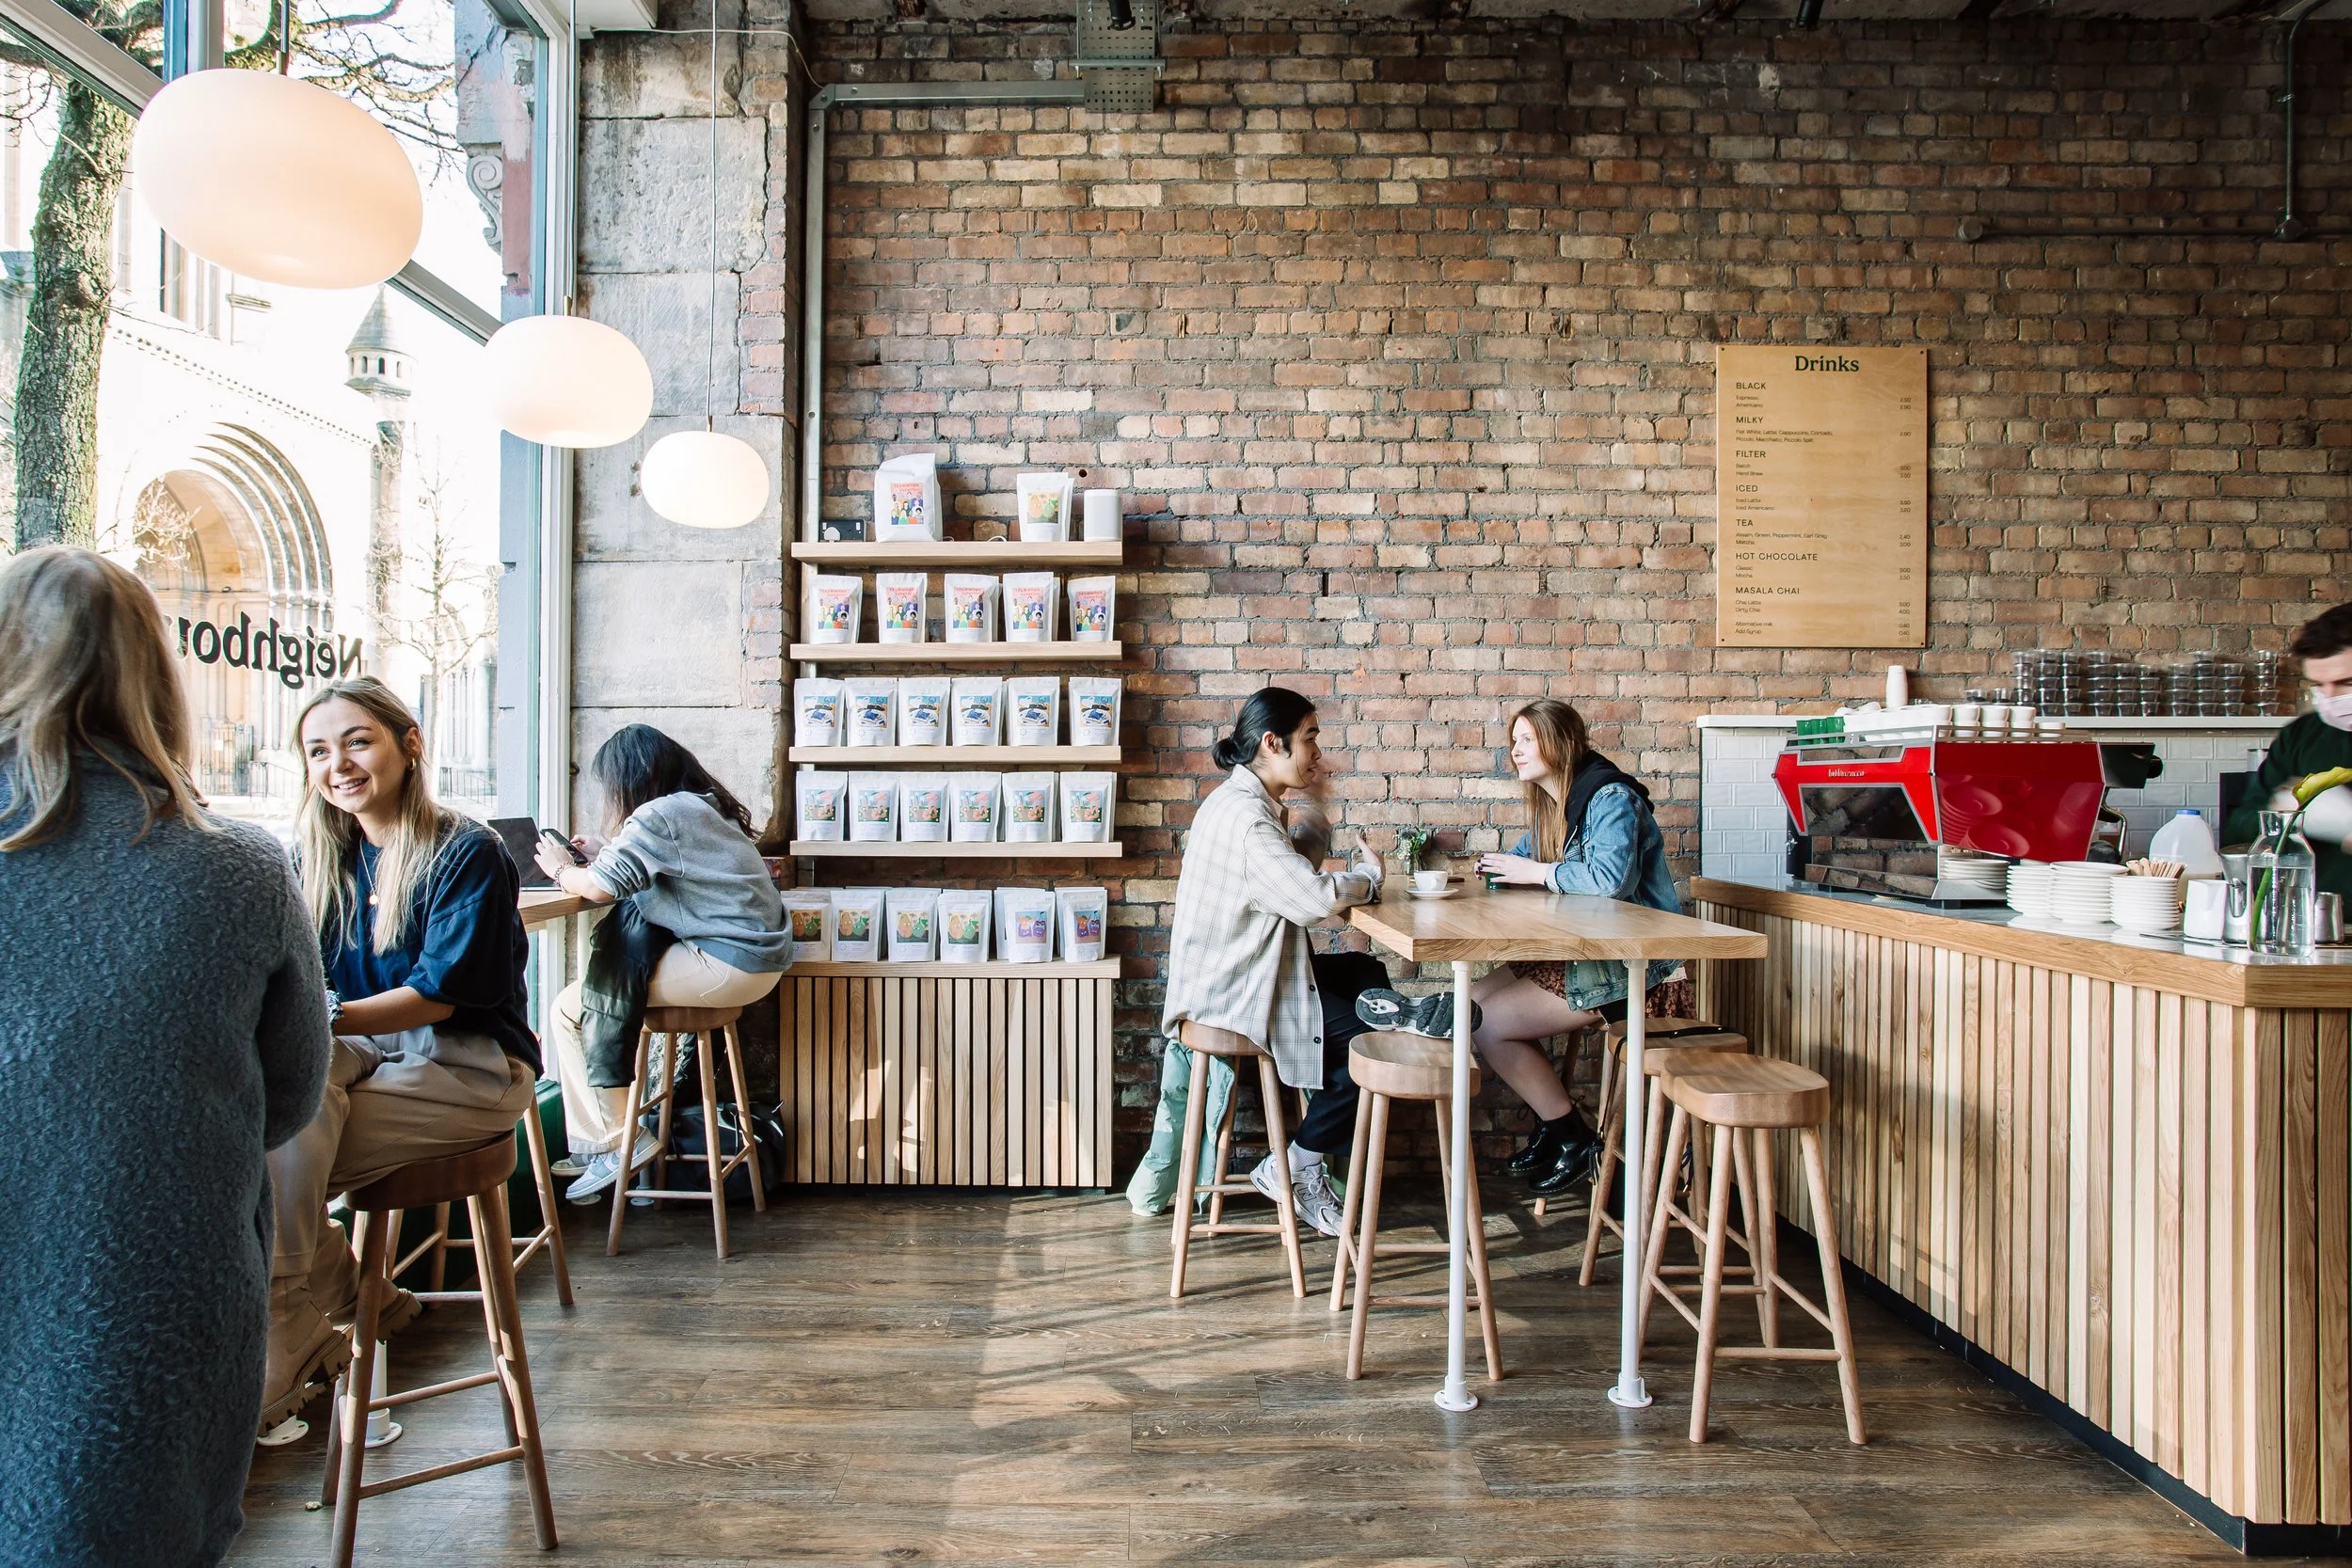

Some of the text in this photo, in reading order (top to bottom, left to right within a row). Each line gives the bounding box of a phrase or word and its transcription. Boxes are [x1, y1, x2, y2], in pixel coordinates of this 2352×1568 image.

[1794, 355, 1860, 373] Drinks
[1735, 382, 1767, 390] BLACK
[1735, 416, 1764, 424] MILKY
[1735, 450, 1767, 459] FILTER
[1735, 484, 1758, 493] ICED
[1735, 518, 1754, 527] TEA
[1735, 552, 1819, 562] HOT CHOCOLATE
[1735, 586, 1800, 595] MASALA CHAI
